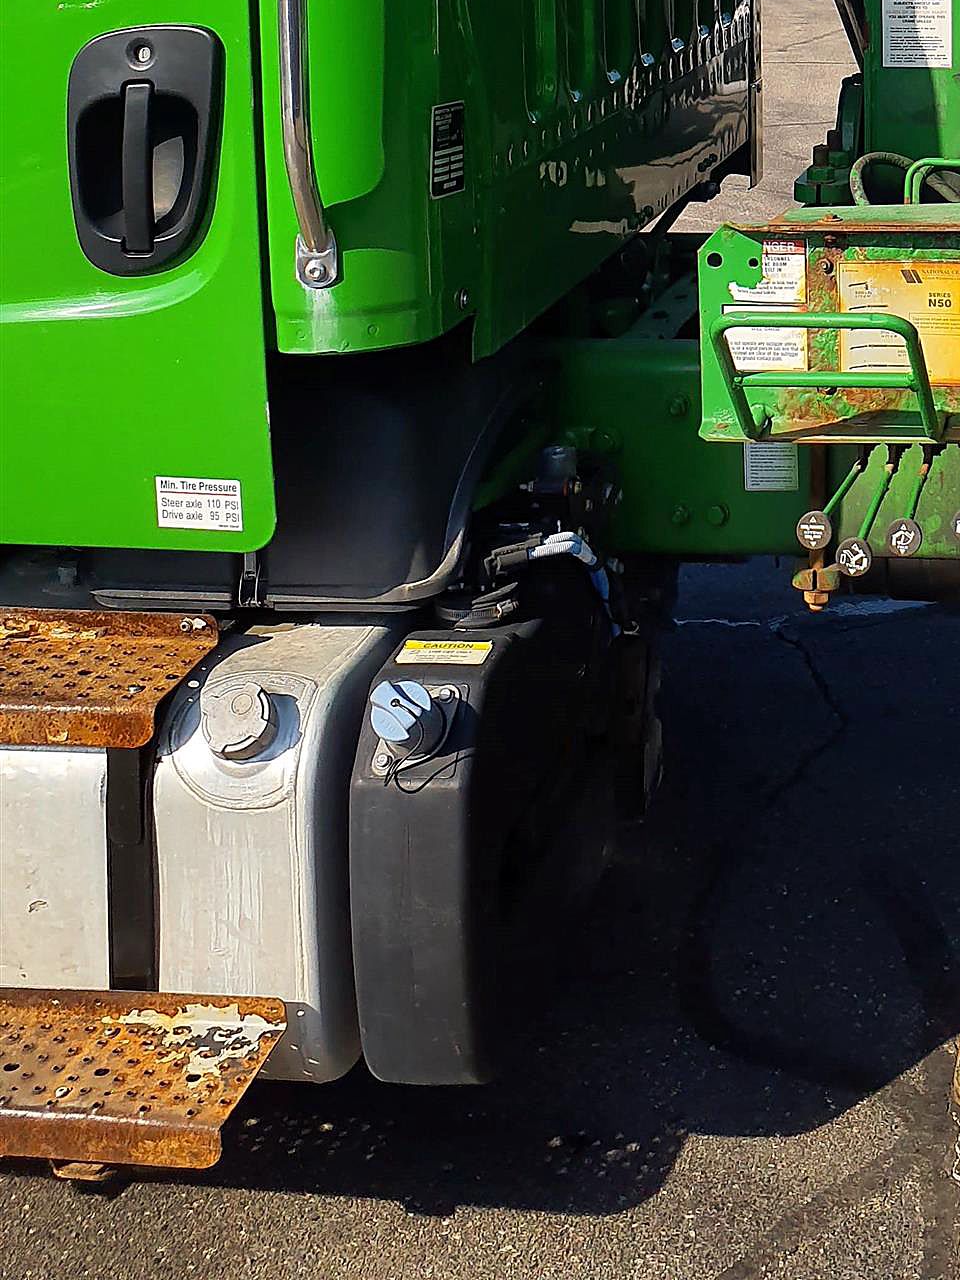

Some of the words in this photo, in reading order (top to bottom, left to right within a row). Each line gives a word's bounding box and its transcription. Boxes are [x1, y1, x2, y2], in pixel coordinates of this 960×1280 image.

[928, 299, 952, 308] N50
[160, 480, 178, 490] Min.
[180, 480, 197, 491] Tire
[199, 481, 237, 492] Pressure
[161, 497, 183, 508] Steer
[185, 499, 202, 508] axle
[207, 499, 221, 509] 110
[224, 500, 239, 510] PSI
[162, 509, 184, 520] Drive
[186, 511, 203, 520] axle
[209, 511, 220, 521] 95
[225, 512, 240, 522] PSI
